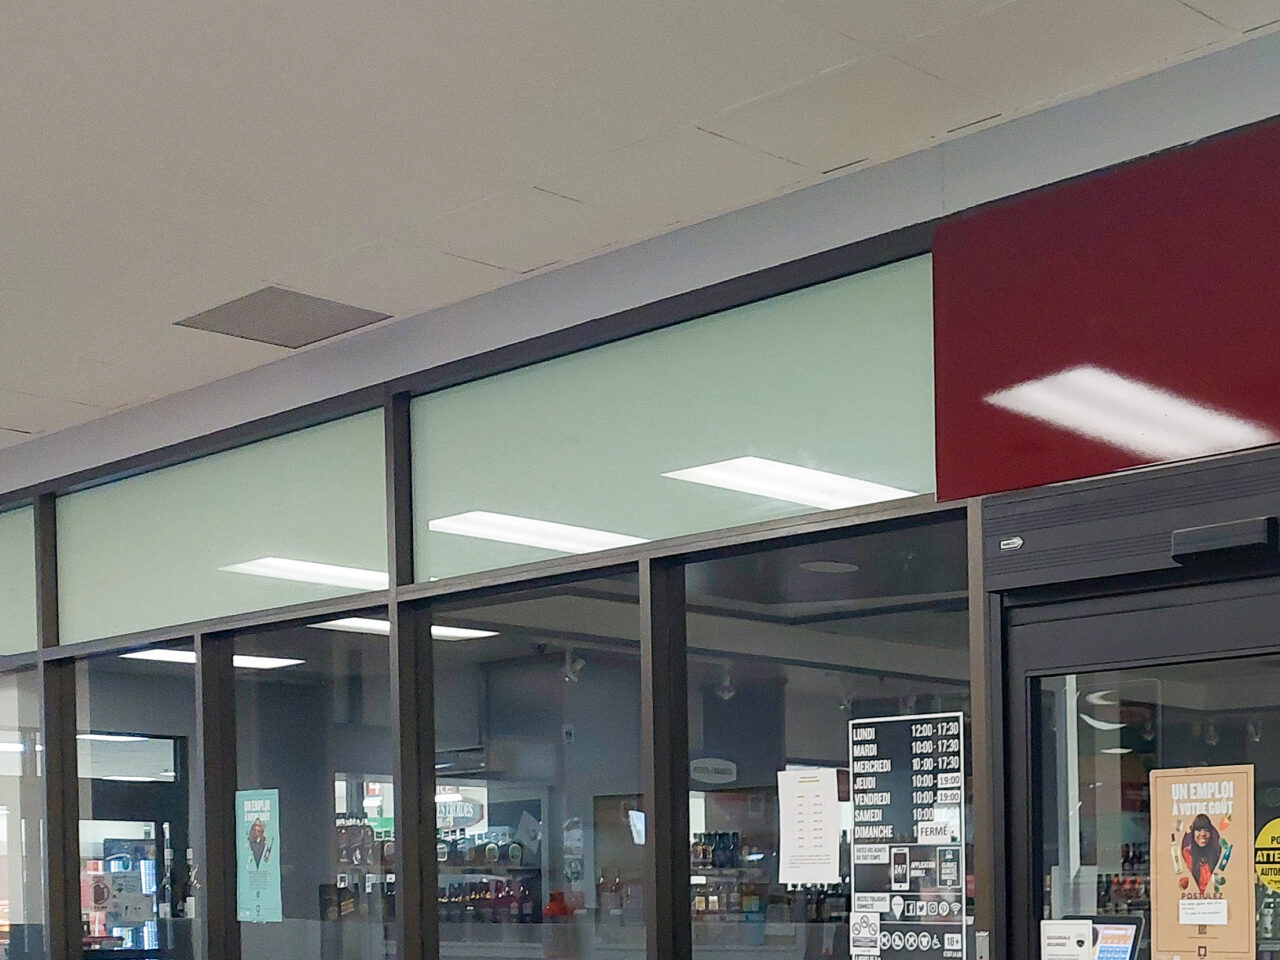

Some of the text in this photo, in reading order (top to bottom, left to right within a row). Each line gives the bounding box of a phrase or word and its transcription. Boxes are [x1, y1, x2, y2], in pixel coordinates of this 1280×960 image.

[853, 728, 875, 741] LUNDI
[853, 744, 877, 757] MARDI
[853, 759, 891, 773] MERCREDI
[854, 777, 876, 790] JEUDI
[1171, 781, 1234, 800] UN EMPLOI
[854, 792, 891, 805] VENDREDI
[1172, 799, 1234, 816] À VOTRE GOÛT
[855, 808, 882, 822] SAMEDI
[855, 825, 894, 839] DIMANCHE
[920, 825, 948, 837] FERMÉ
